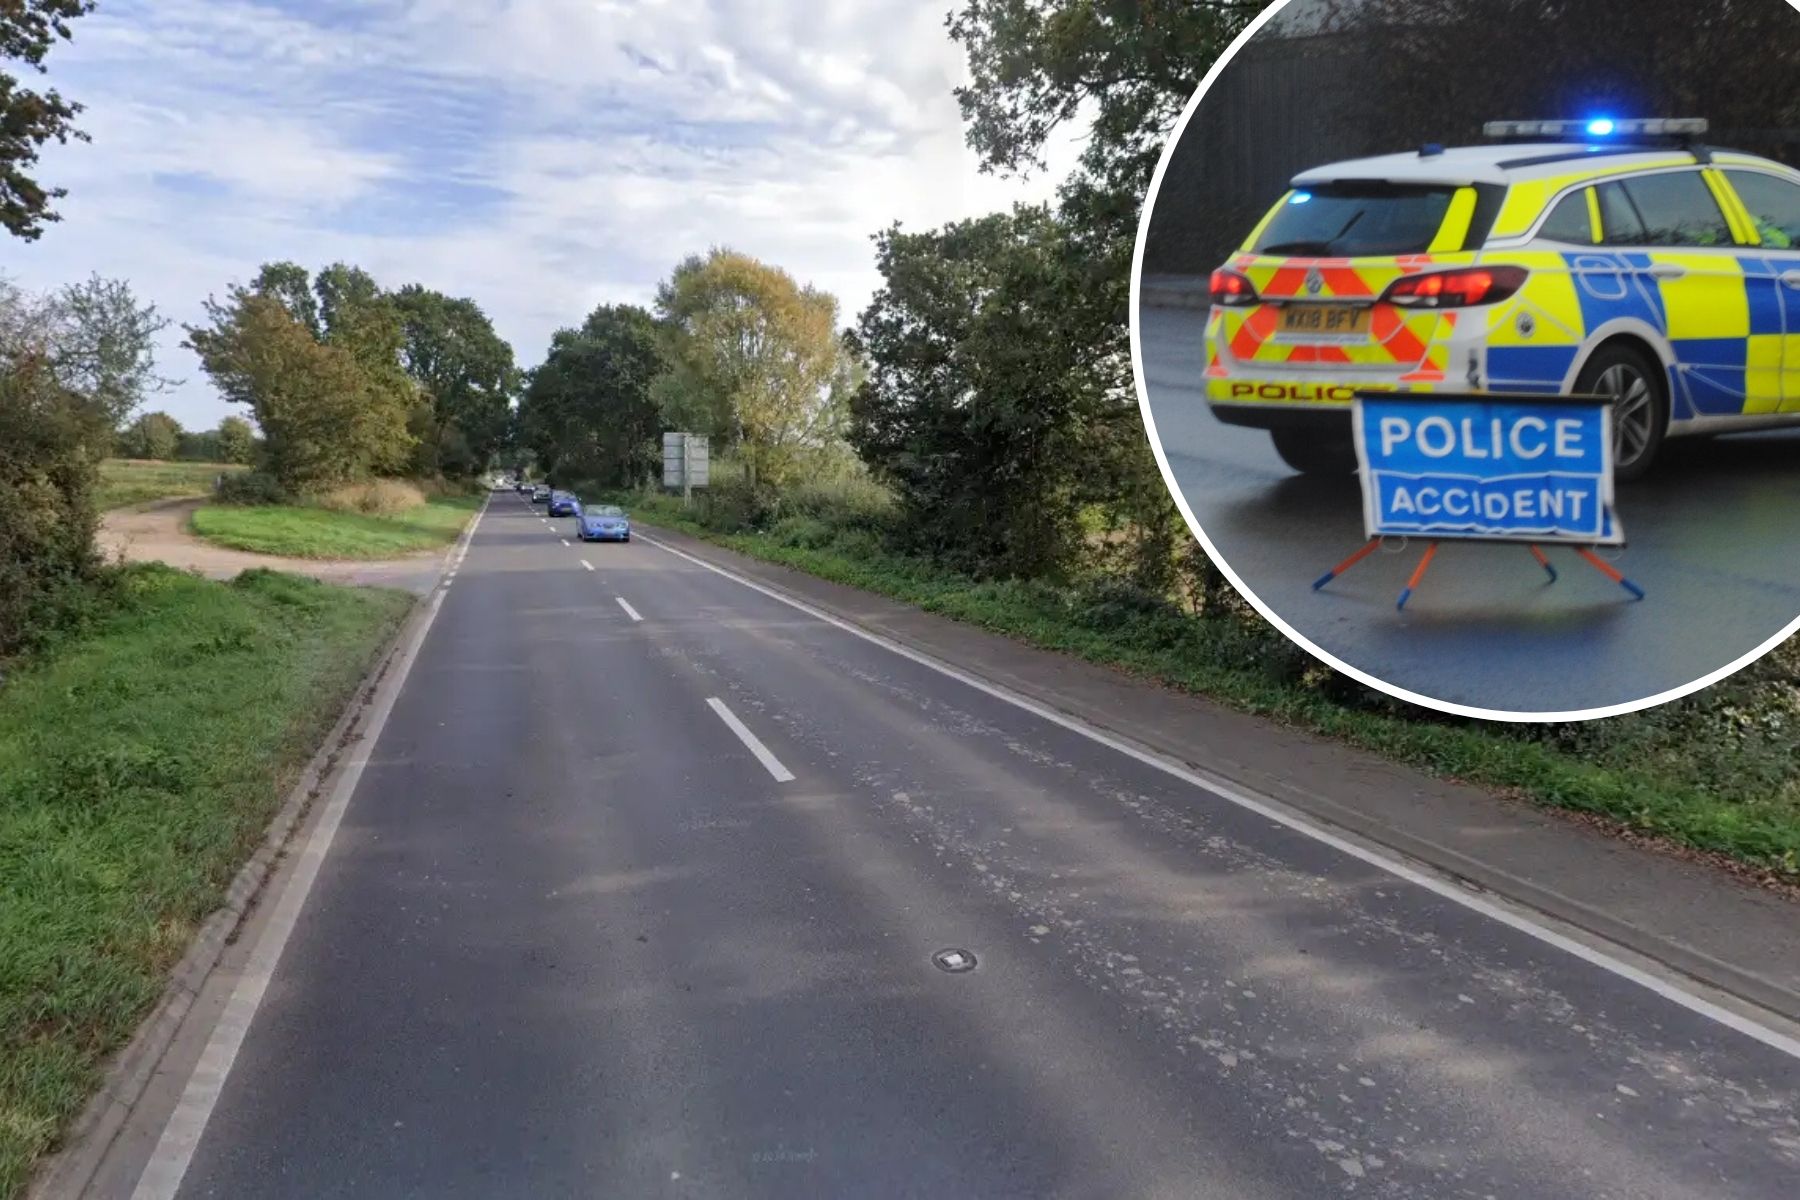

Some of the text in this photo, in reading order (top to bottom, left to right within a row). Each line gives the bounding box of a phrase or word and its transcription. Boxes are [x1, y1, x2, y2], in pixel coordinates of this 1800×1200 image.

[1231, 382, 1390, 401] POLIC
[1380, 416, 1585, 460] POLICE
[1390, 486, 1588, 521] ACCIDENT
